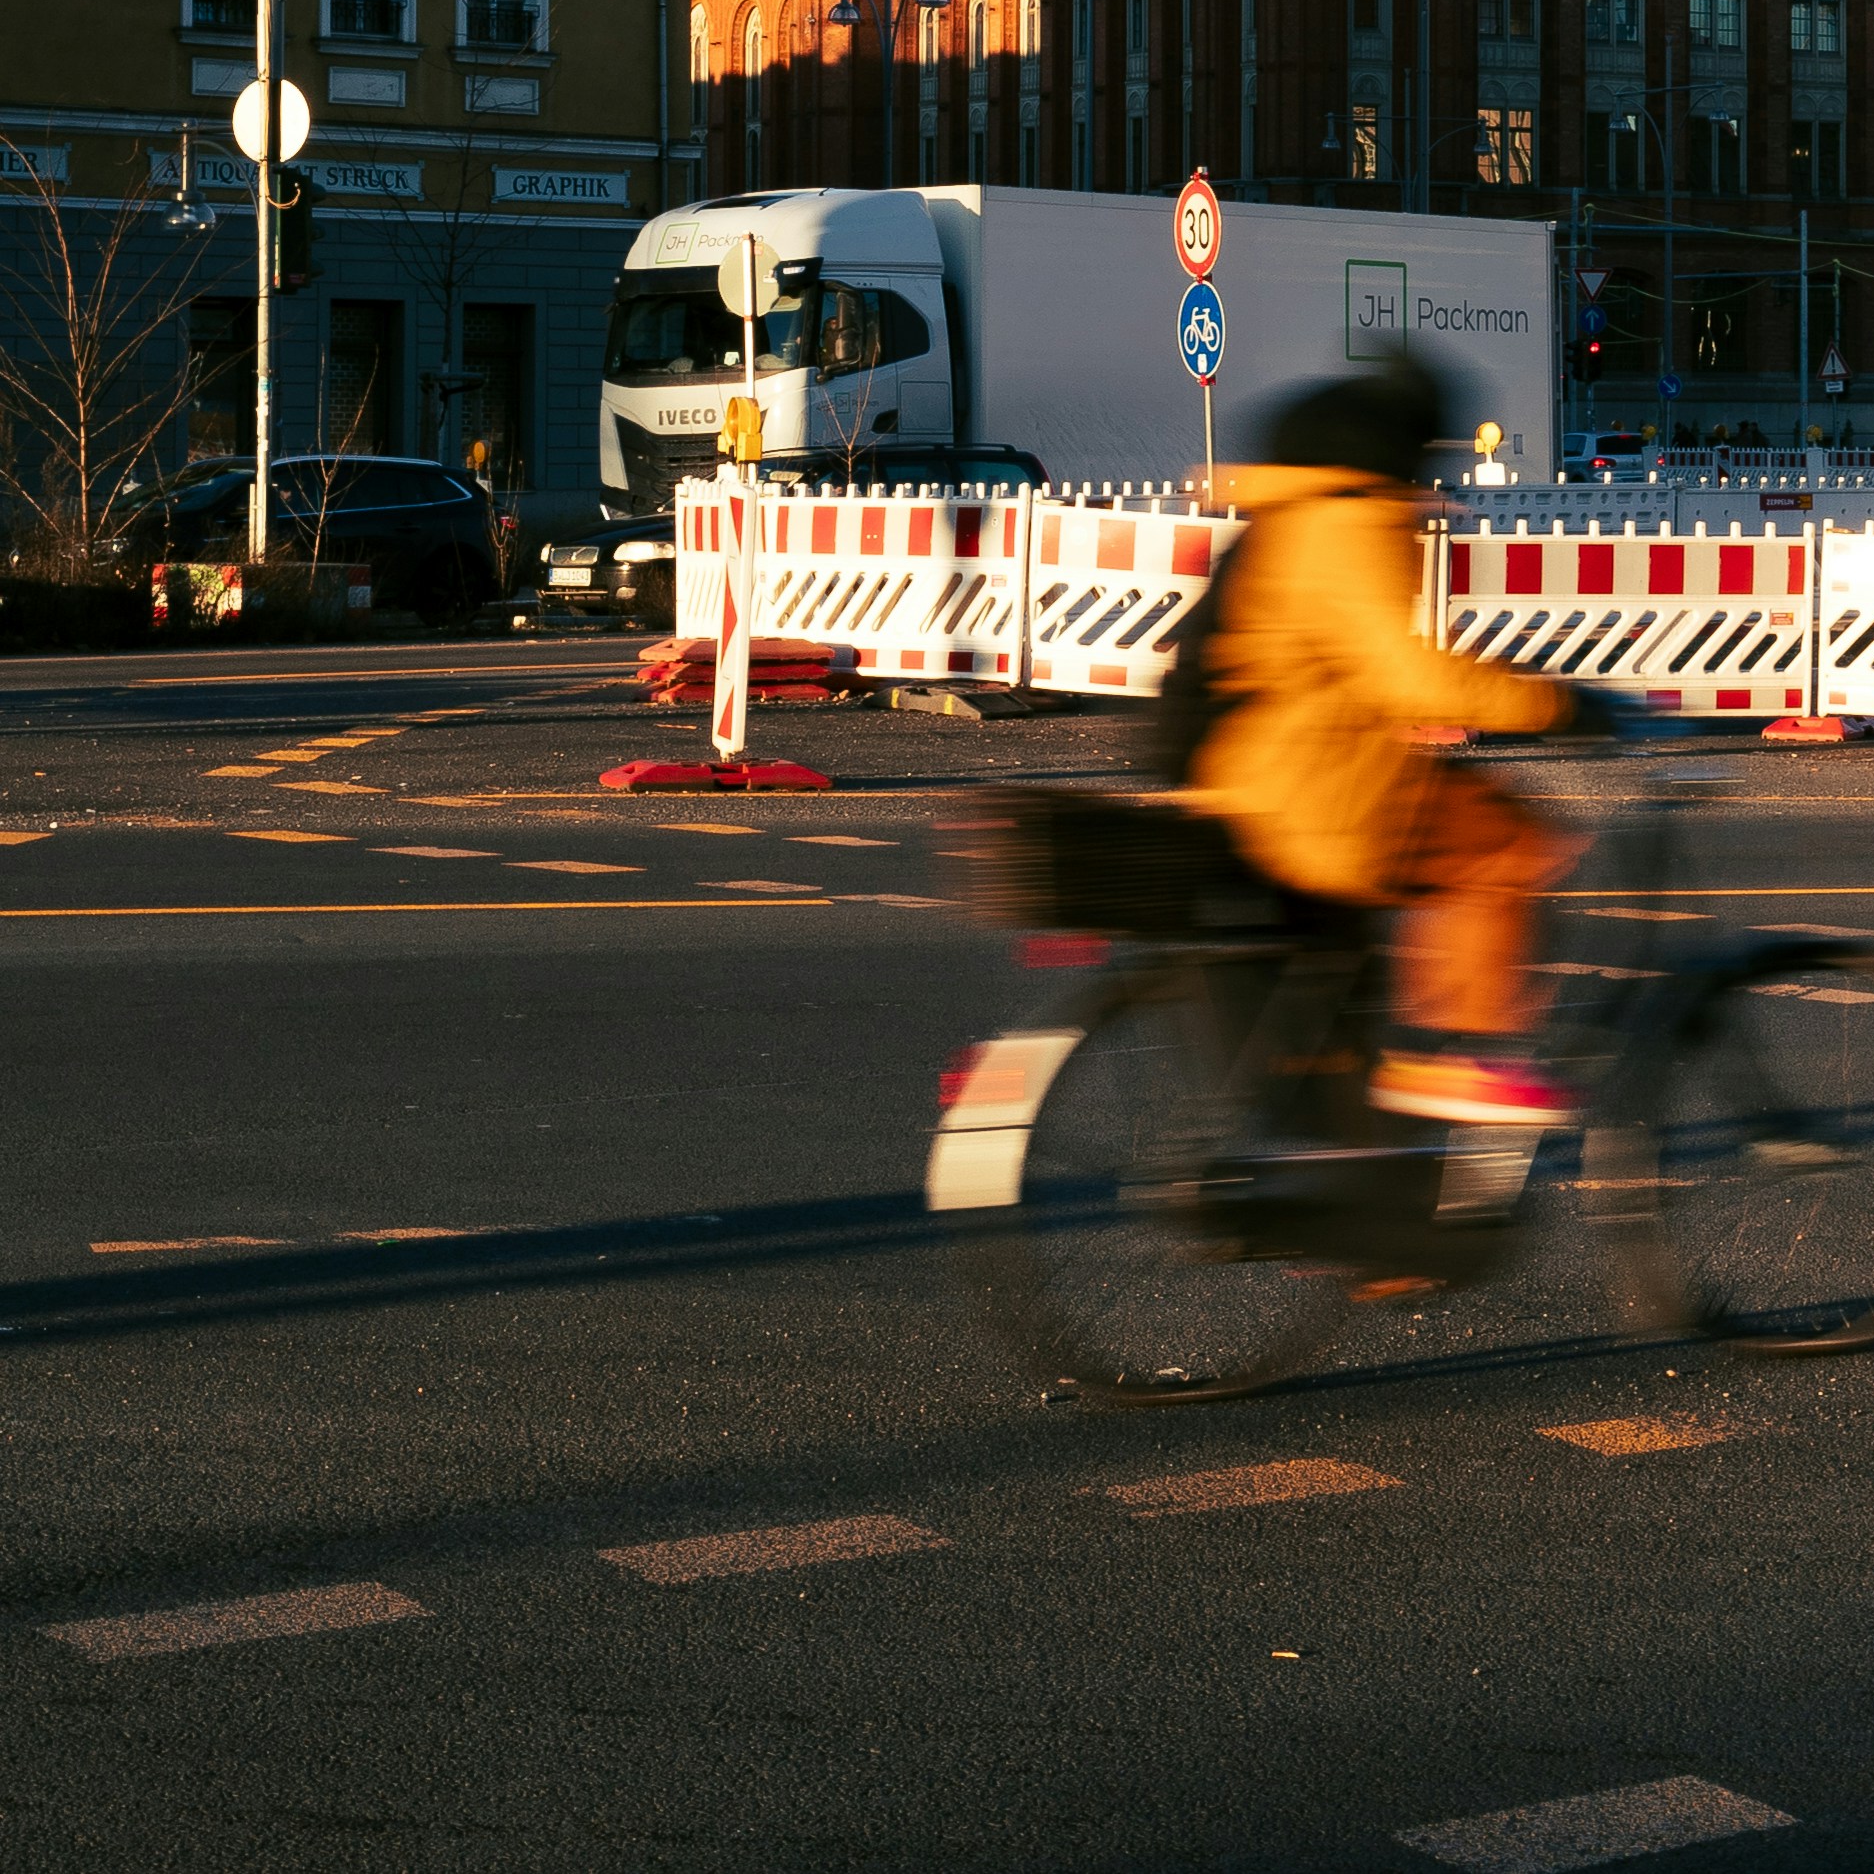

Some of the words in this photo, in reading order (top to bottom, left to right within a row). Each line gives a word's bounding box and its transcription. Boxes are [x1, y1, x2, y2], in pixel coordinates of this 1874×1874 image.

[0, 151, 38, 173] ER
[326, 165, 409, 190] STRUCK
[512, 174, 611, 198] GRAPHIK
[1184, 208, 1210, 250] 30
[665, 236, 688, 250] JH
[698, 234, 764, 248] Packmn
[1358, 294, 1394, 328] JH
[1417, 297, 1529, 333] Packman
[658, 408, 717, 426] IVECO
